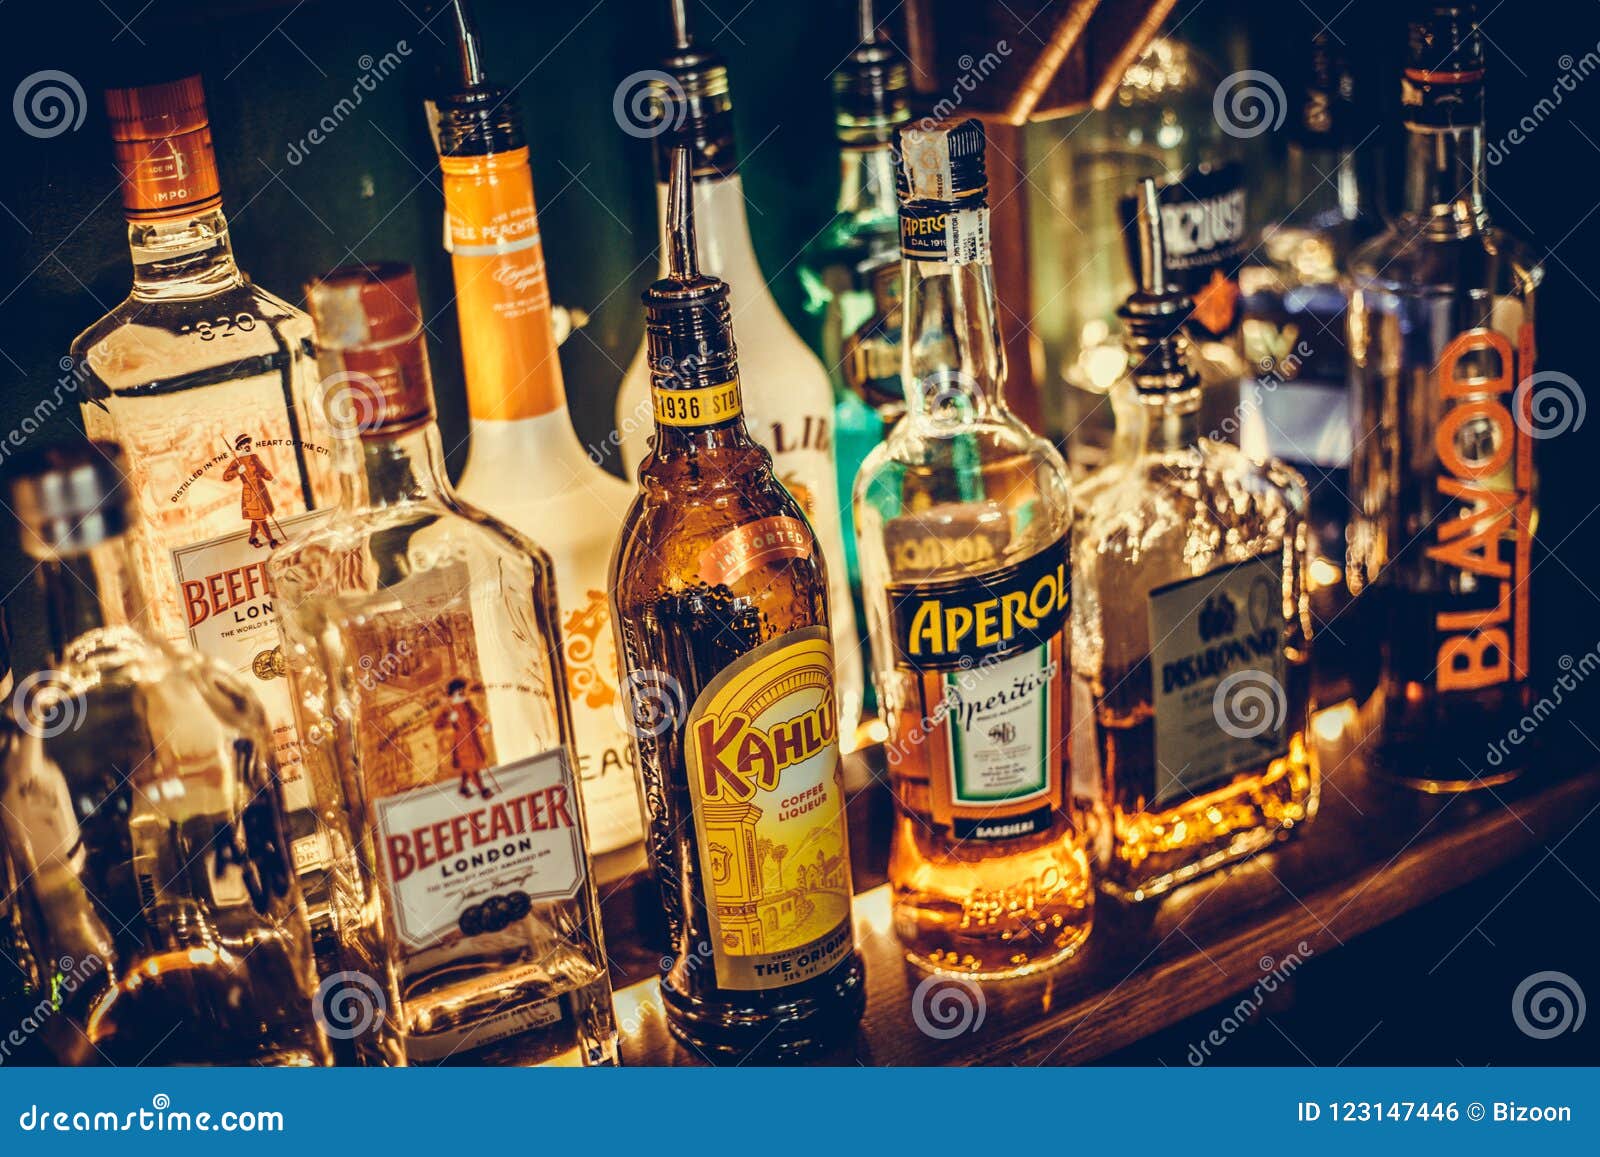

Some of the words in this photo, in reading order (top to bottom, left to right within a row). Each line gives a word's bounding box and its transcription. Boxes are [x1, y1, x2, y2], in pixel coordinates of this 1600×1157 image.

[911, 237, 929, 247] DAL
[180, 312, 256, 341] 820
[660, 396, 700, 419] 1936
[171, 469, 204, 503] DISTILLED
[204, 462, 213, 471] IN
[213, 452, 229, 464] THE
[255, 439, 283, 448] HEART
[299, 441, 314, 451] THE
[1426, 326, 1515, 692] BLAVOD
[715, 531, 805, 571] IMPORTED
[908, 563, 1070, 656] APEROL
[221, 629, 235, 639] THE
[236, 621, 269, 636] WORLD'S
[698, 688, 835, 798] KAHLÚ
[779, 793, 828, 822] LIQUEUR
[781, 782, 824, 809] COFFEE
[386, 784, 575, 883] BEEFEATER
[441, 838, 533, 877] LONDON
[754, 960, 791, 977] THE
